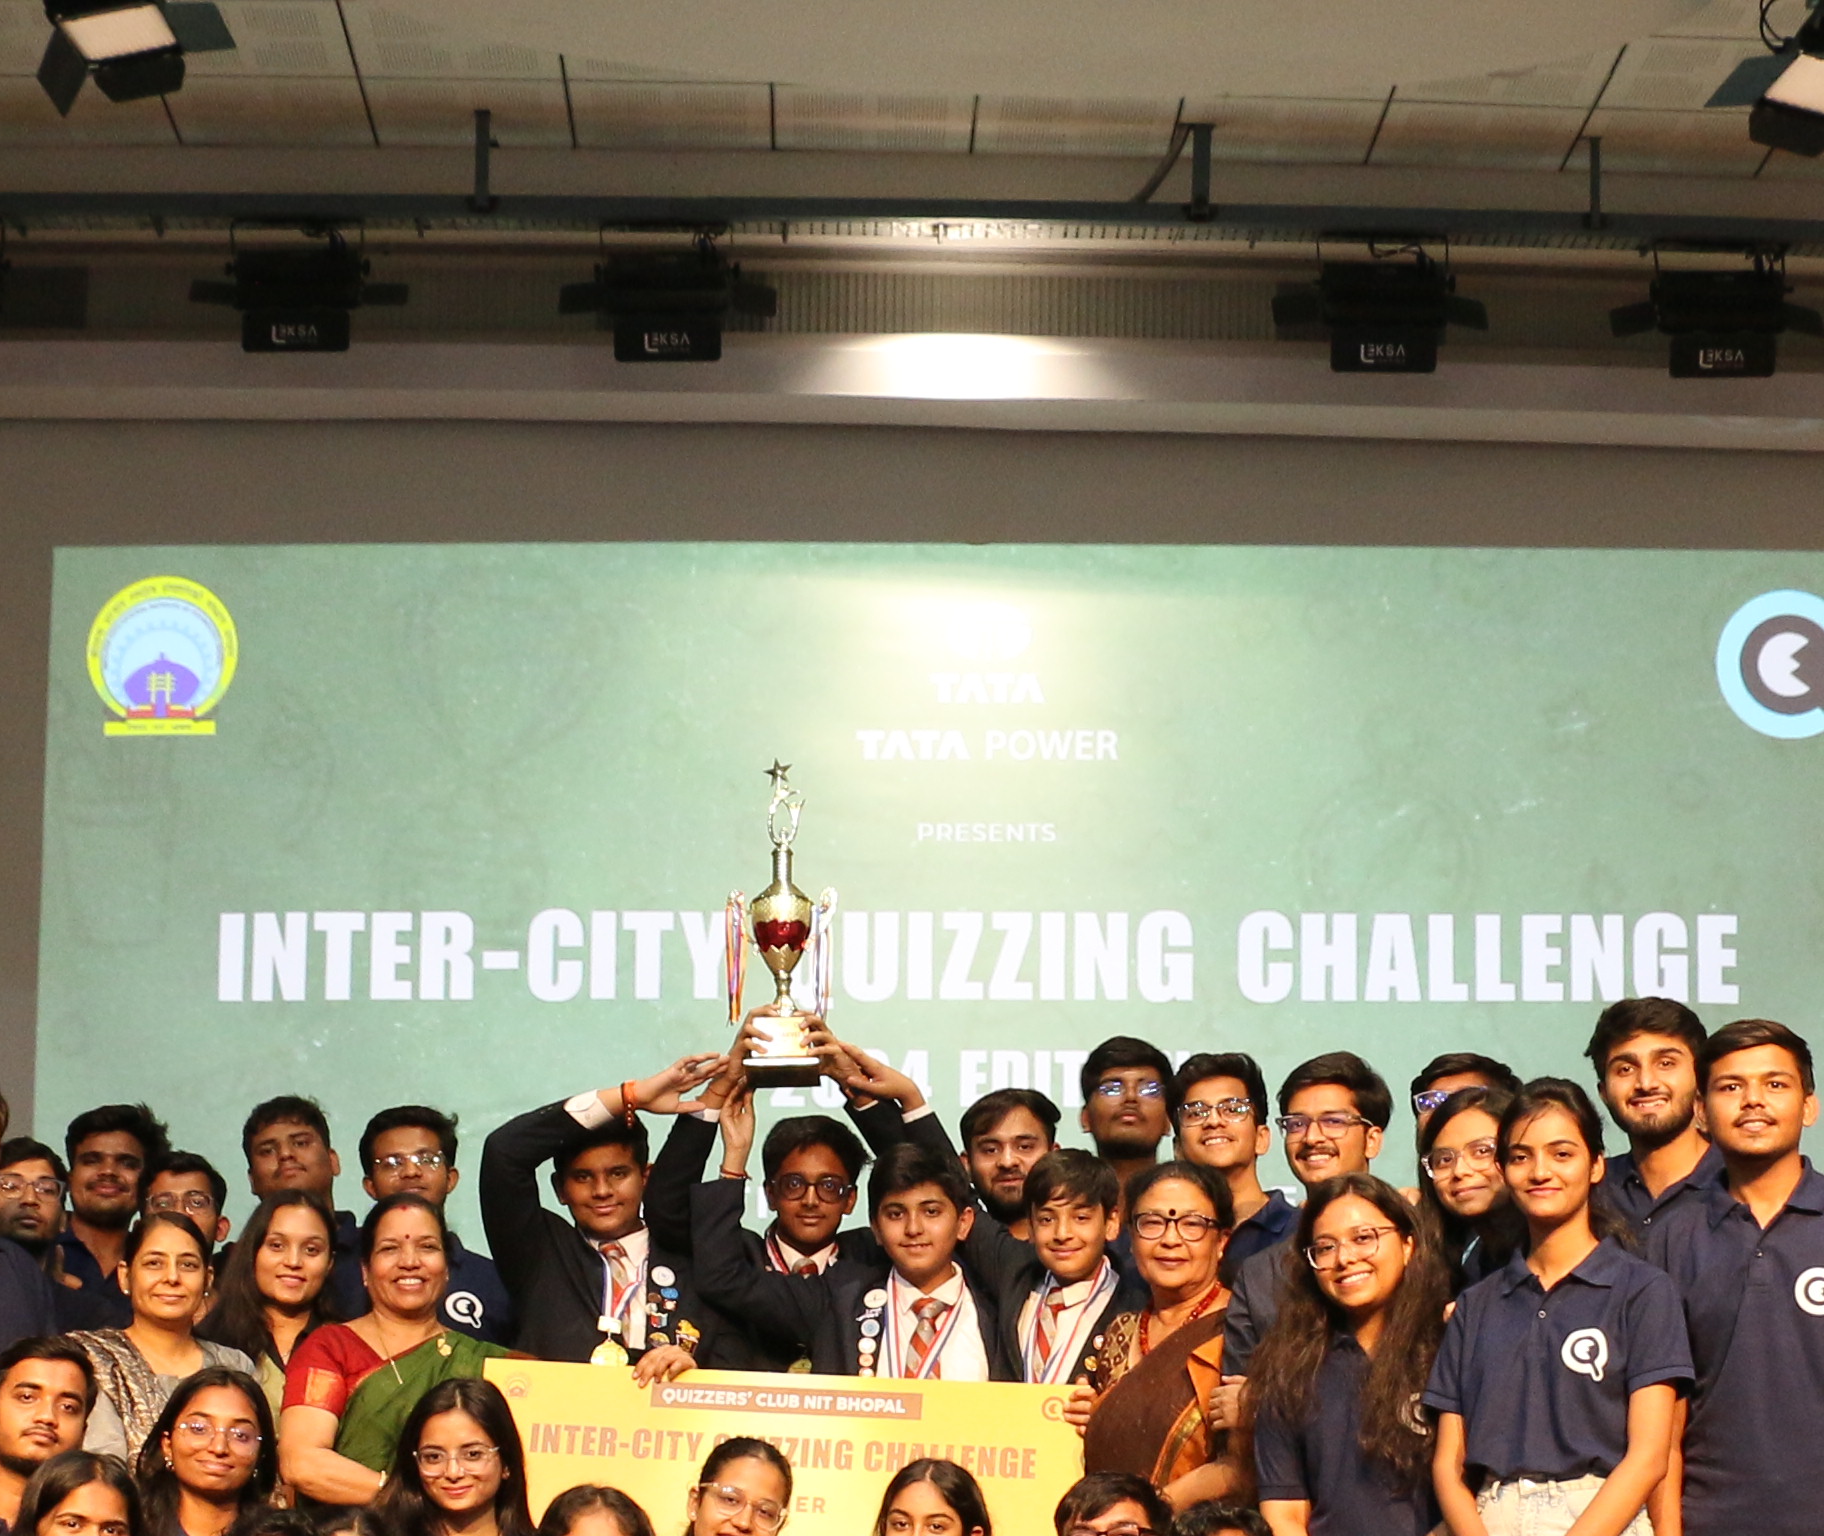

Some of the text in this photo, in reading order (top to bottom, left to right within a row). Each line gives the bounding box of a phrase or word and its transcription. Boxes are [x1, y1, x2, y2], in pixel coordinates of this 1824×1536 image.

[928, 673, 1046, 703] TATA
[857, 730, 1118, 760] TATA POWER
[917, 822, 1056, 842] PRESENTS
[217, 910, 727, 1001] INTER-CITY
[1237, 911, 1739, 1005] CHALLENGE
[661, 1388, 906, 1414] QUIZZERS' CLUB NIT BHOPAL
[529, 1423, 704, 1462] INTER-CITY
